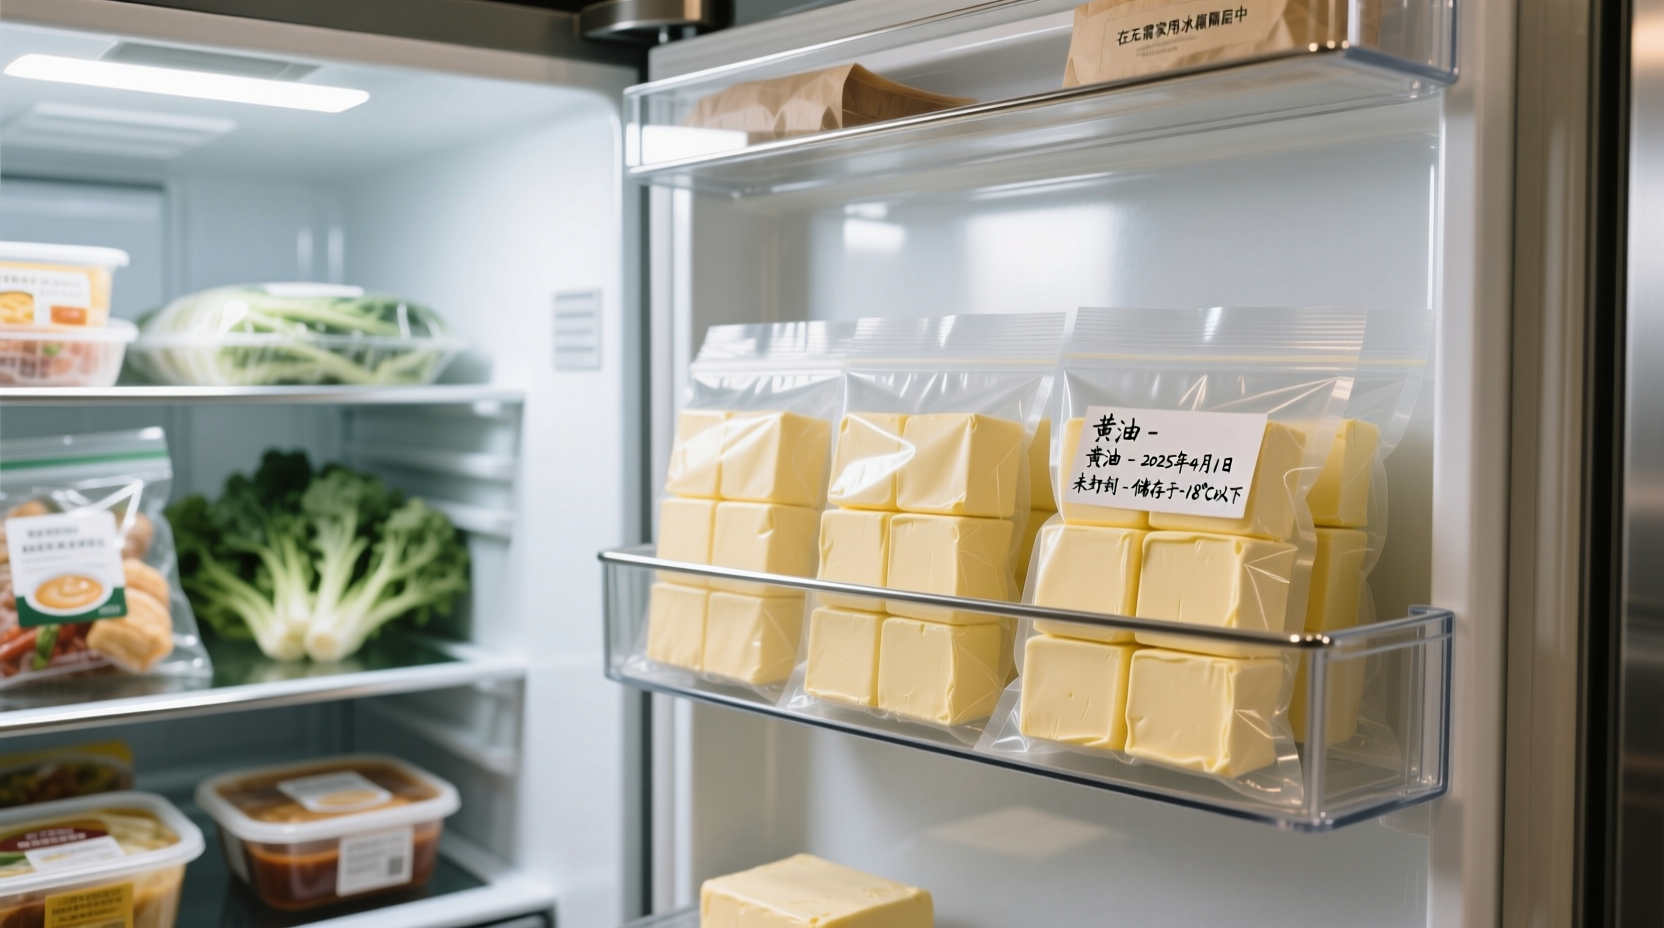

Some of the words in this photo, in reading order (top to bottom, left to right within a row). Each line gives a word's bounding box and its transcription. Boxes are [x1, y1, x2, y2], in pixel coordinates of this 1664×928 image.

[1093, 413, 1140, 443] 黄油
[1086, 445, 1121, 468] 黄油
[1140, 450, 1233, 475] 2025年4月1日
